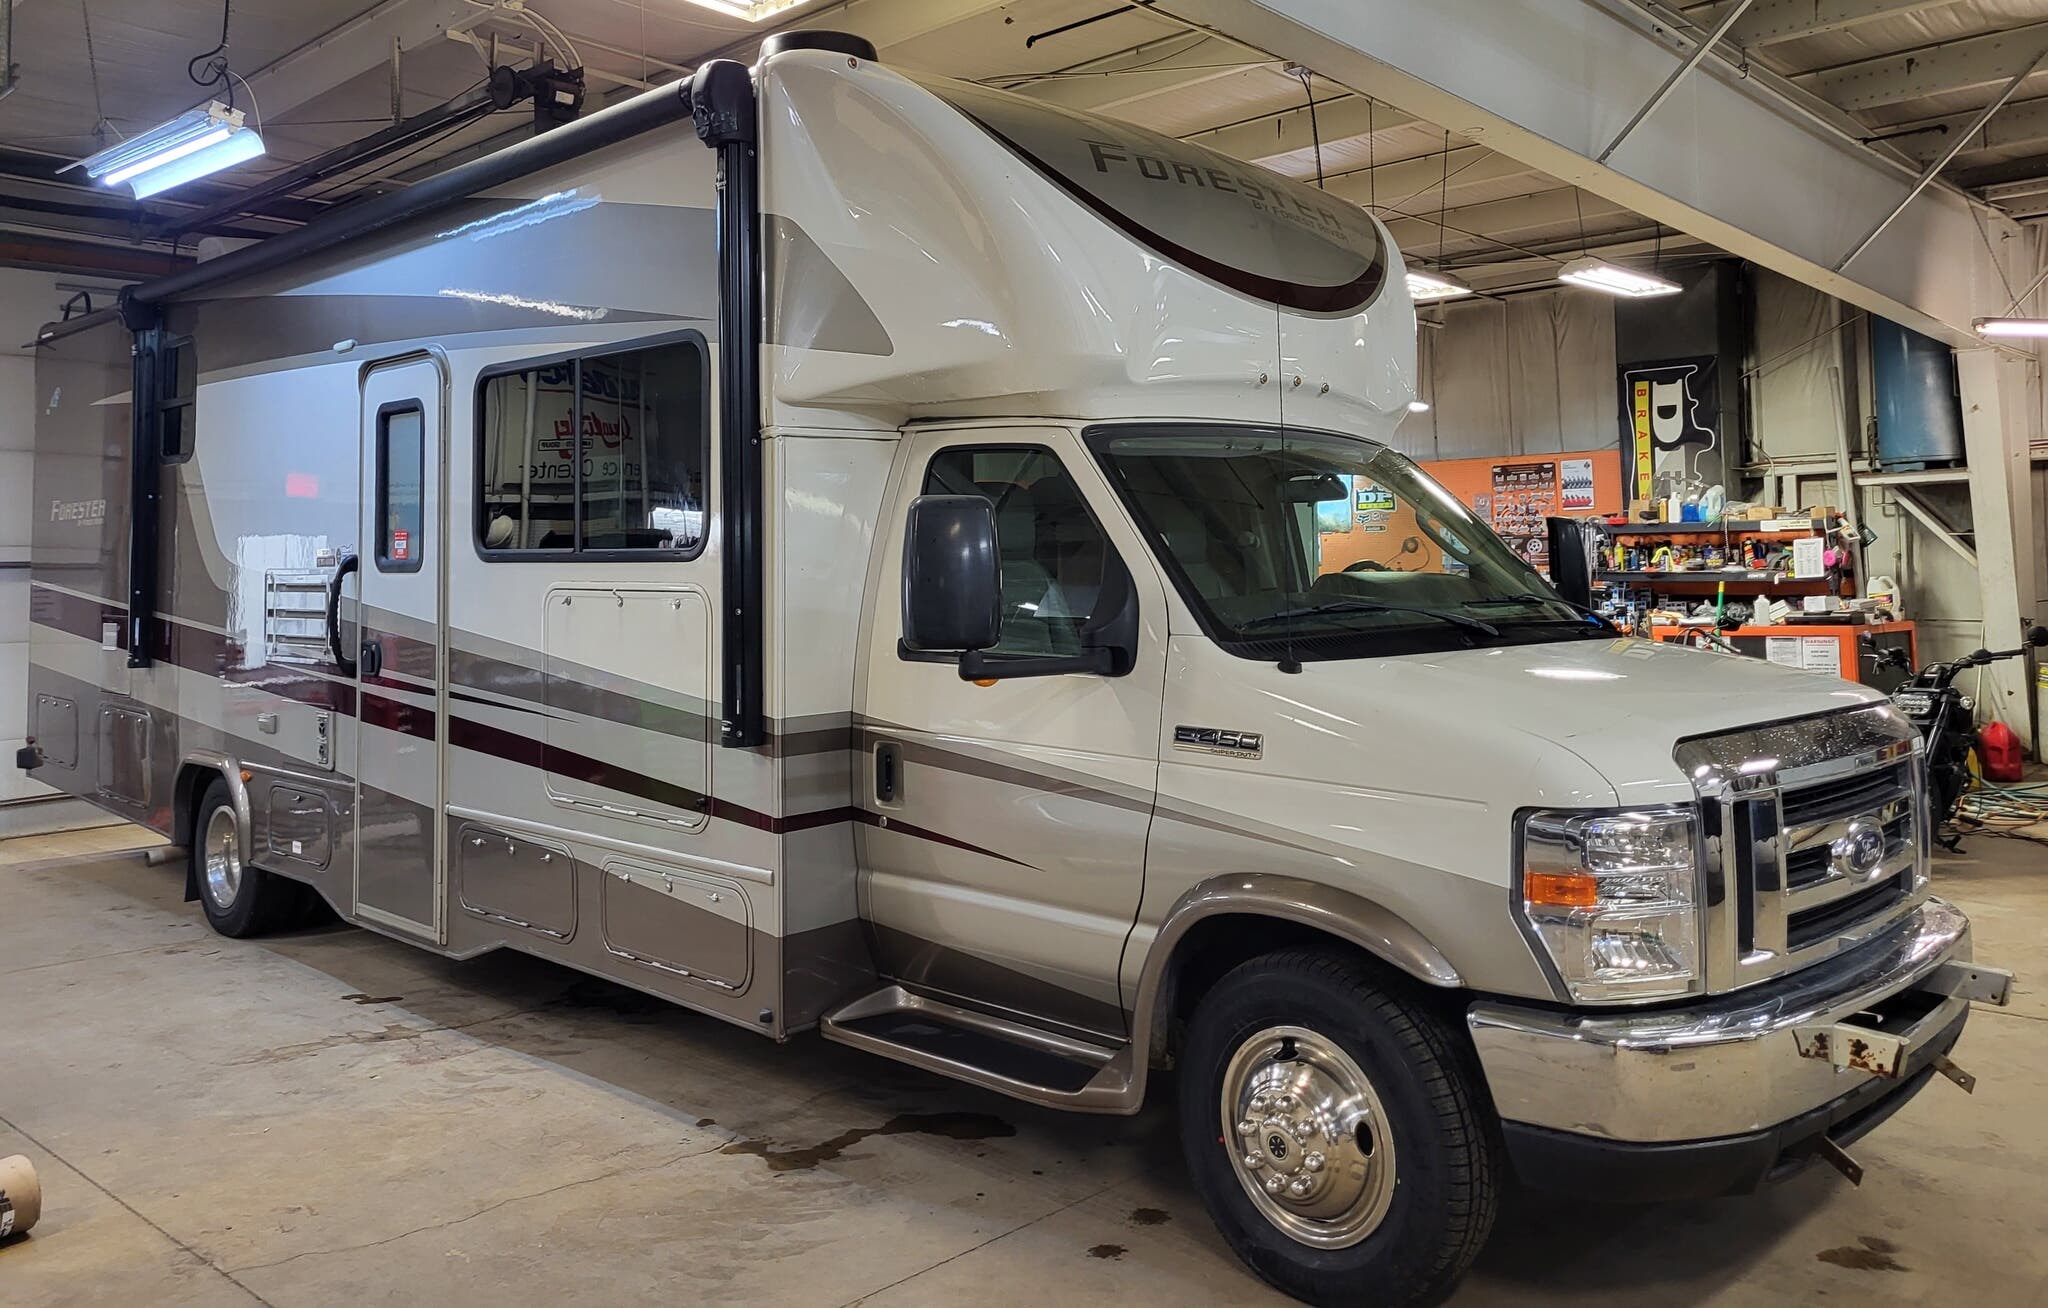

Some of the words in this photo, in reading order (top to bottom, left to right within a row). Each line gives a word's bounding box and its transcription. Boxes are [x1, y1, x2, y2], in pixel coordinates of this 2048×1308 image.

[1087, 143, 1342, 231] FORESTER
[1636, 388, 1650, 500] BRAKES
[50, 499, 107, 522] FORESTER
[1861, 836, 1881, 864] Ford
